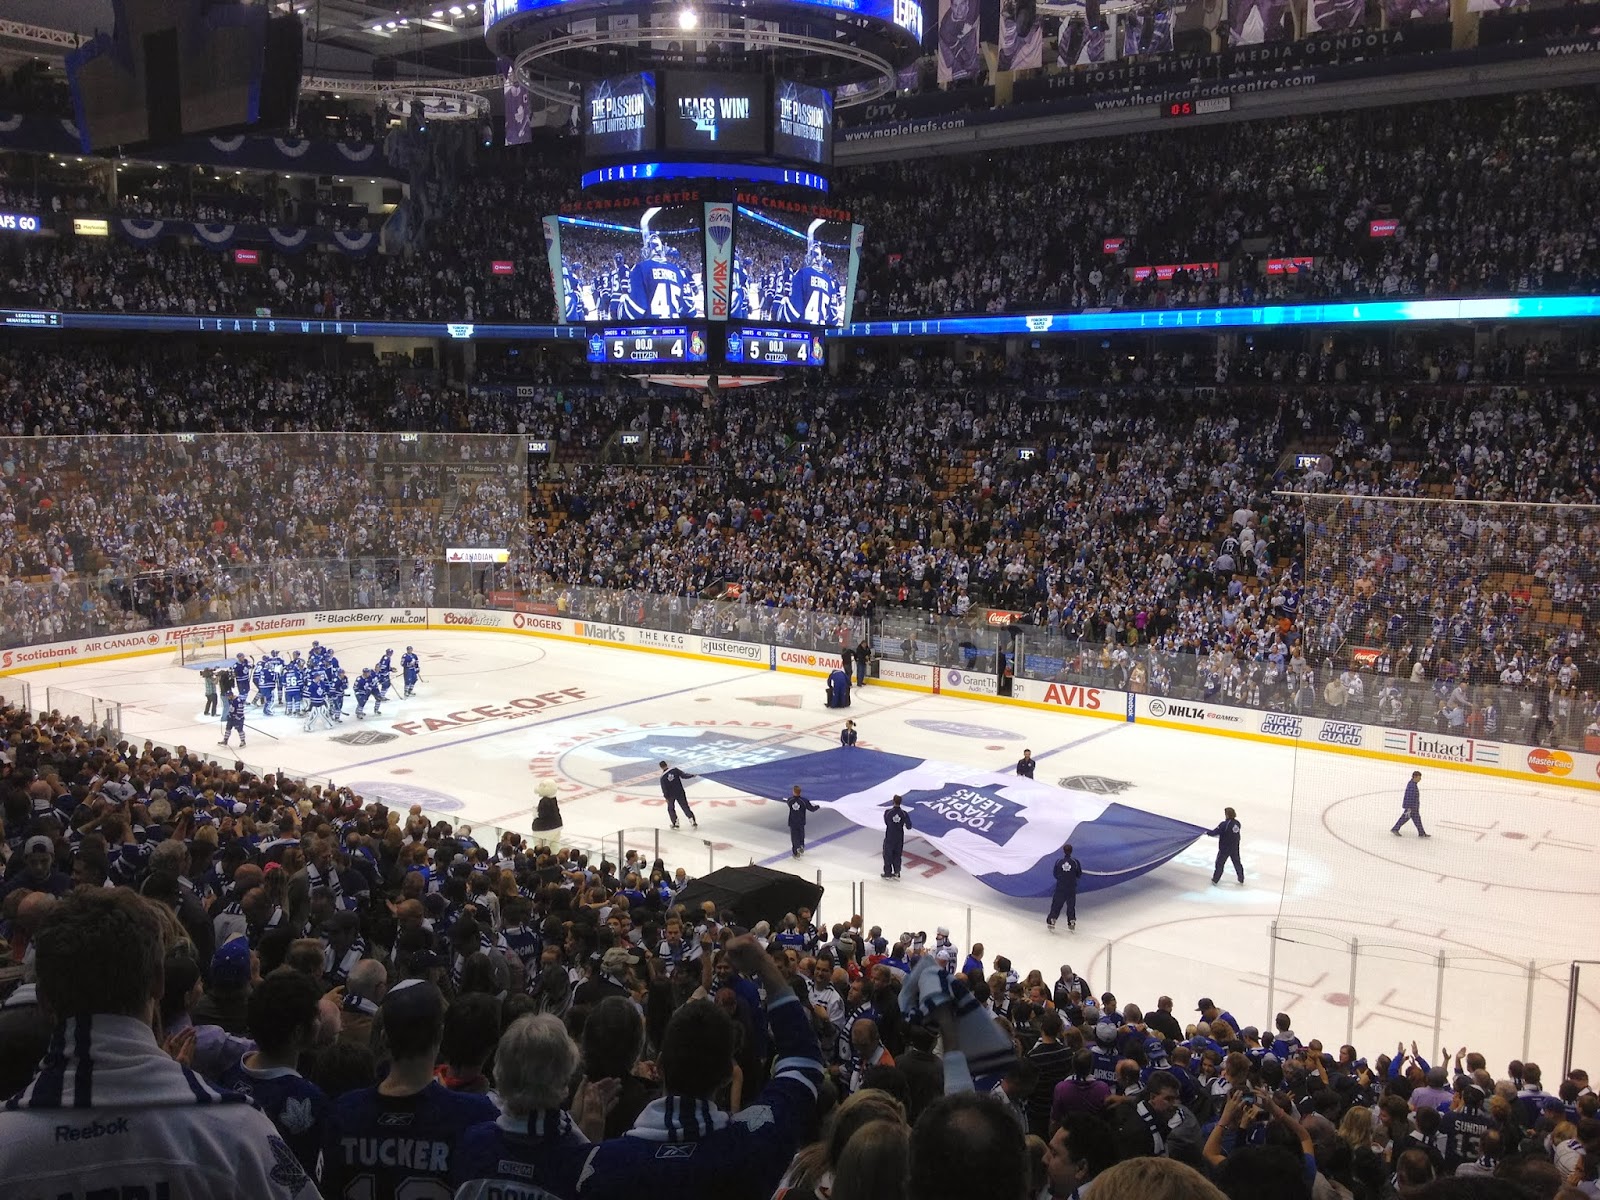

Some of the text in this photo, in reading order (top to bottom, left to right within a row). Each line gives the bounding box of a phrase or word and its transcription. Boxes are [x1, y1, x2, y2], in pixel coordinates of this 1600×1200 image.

[1048, 31, 1404, 89] THE FOSTER HEWITT MEDIA GONDOLA
[592, 93, 645, 117] THE PASSION
[679, 97, 749, 119] LEAFS WIN!
[781, 98, 824, 129] THE PASSION
[593, 119, 606, 134] THAT
[845, 118, 965, 142] www.mapleleafs.com
[600, 166, 652, 181] LEAFS
[587, 197, 640, 209] CANADA
[645, 191, 699, 205] CENTRE
[737, 192, 758, 205] AIR
[762, 198, 808, 214] CANADA
[19, 217, 35, 230] GO
[712, 259, 728, 316] RE/MAX
[200, 318, 357, 334] LEAFS WIN!
[1141, 311, 1222, 326] LEAFS
[892, 321, 941, 334] WIN!
[613, 340, 624, 358] 5
[635, 338, 653, 350] 00.0
[670, 339, 684, 358] 4
[749, 340, 760, 359] 5
[768, 340, 784, 352] 00.0
[630, 351, 658, 360] CITIZEN
[764, 353, 788, 361] CITIZEN
[797, 343, 807, 361] 4
[518, 388, 533, 396] 105
[401, 434, 418, 442] IBM
[623, 435, 640, 444] IBM
[529, 442, 546, 451] IBM
[327, 613, 383, 624] BlackBerry
[390, 616, 426, 624] NHL.COM
[444, 612, 474, 625] Coors
[527, 617, 562, 631] ROGERS
[584, 623, 625, 642] Mark's
[639, 631, 684, 644] THE KEG
[84, 636, 146, 653] AIR CANADA
[16, 645, 78, 663] Scotiabank
[895, 672, 927, 681] FULBRIGHT
[1043, 684, 1101, 710] AVIS
[391, 687, 588, 736] FACE-OFF
[503, 708, 542, 720] 2013
[1168, 705, 1205, 720] NHL14
[639, 719, 794, 731] CANADA
[1264, 714, 1302, 728] RIGHT
[1261, 723, 1301, 737] GUARD
[1323, 722, 1362, 736] RIGHT
[1319, 731, 1361, 746] GUARD
[1417, 736, 1467, 757] intact
[1417, 751, 1464, 762] INSURANCE
[1528, 756, 1573, 769] MasterCard
[951, 788, 1003, 814] LEAFS
[915, 801, 994, 833] TORONT
[55, 1117, 129, 1142] Reebok
[1454, 1120, 1488, 1135] SUNDIN
[1455, 1133, 1481, 1158] 13
[340, 1137, 449, 1172] TUCKER
[499, 1160, 534, 1177] CCM
